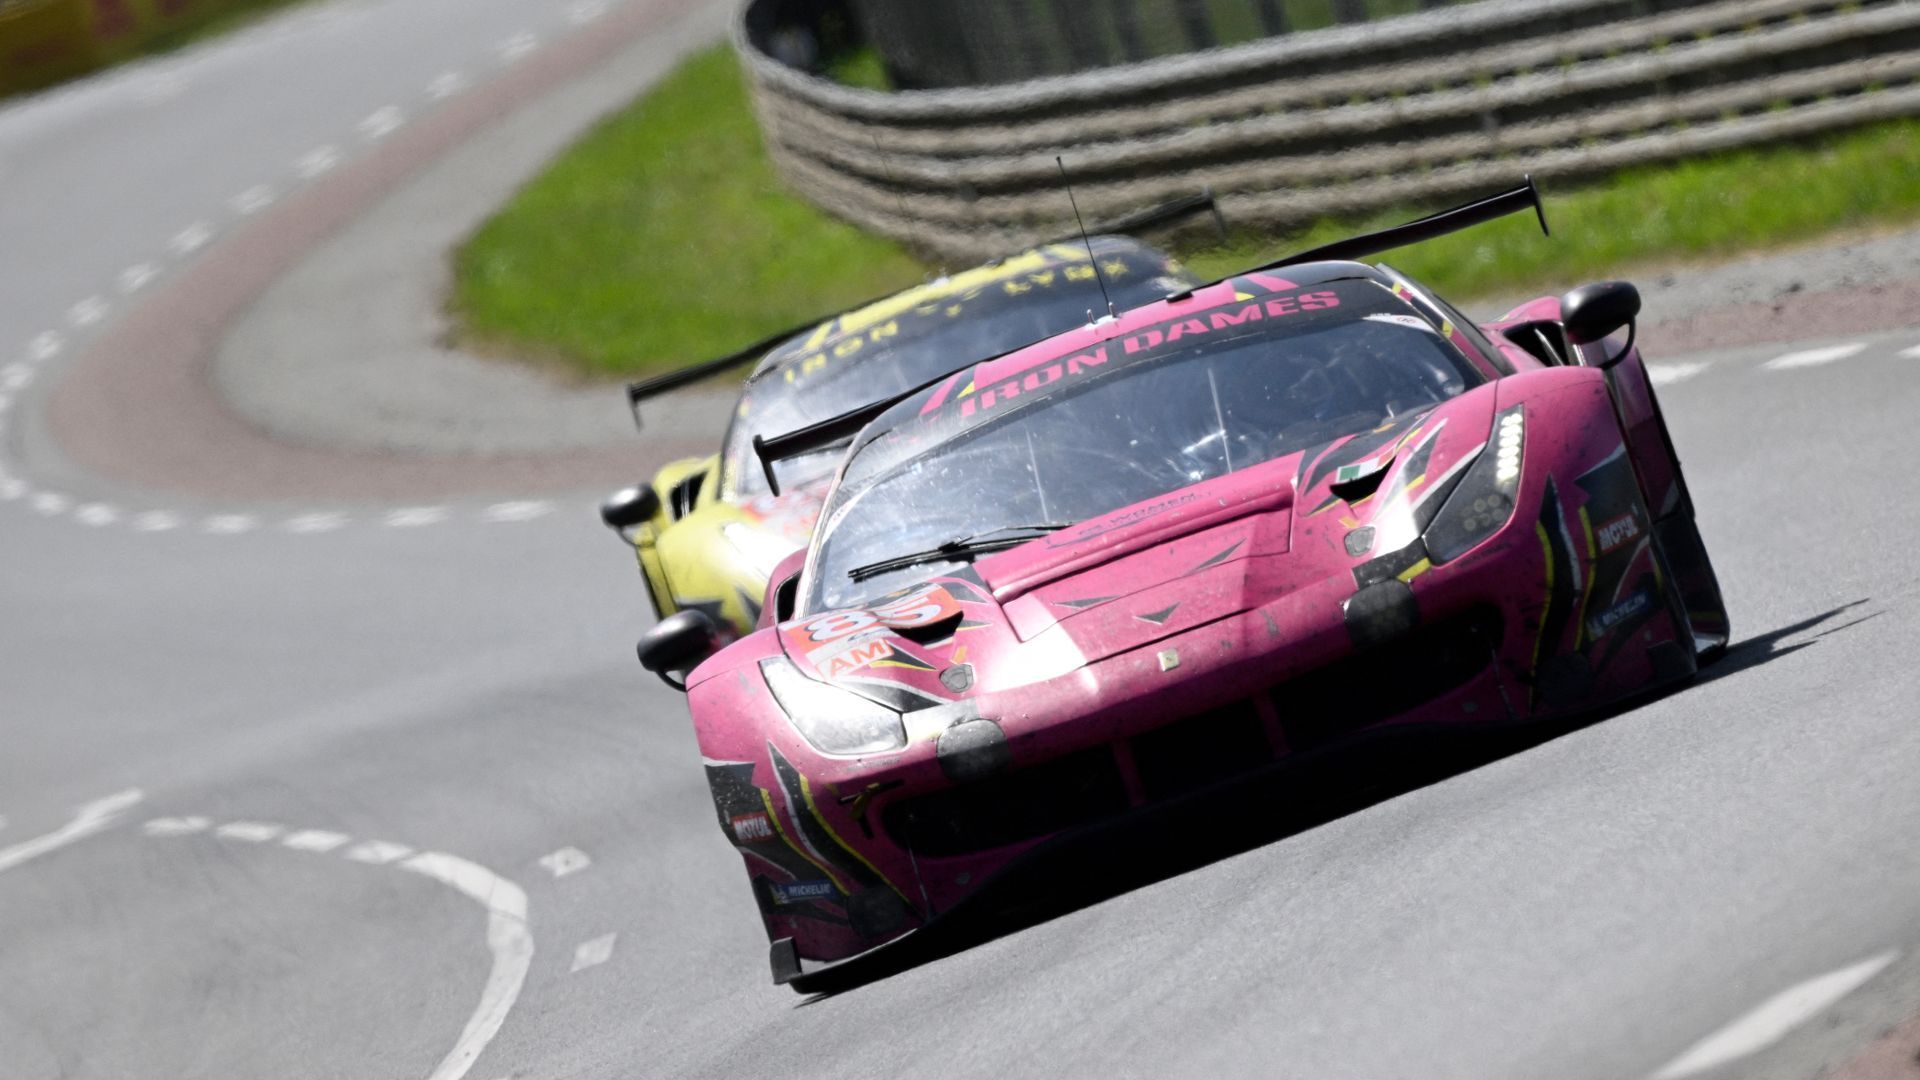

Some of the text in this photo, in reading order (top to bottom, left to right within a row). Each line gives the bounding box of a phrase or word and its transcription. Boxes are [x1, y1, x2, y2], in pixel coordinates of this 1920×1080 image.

[959, 291, 1341, 419] IRON DAMES
[829, 638, 888, 677] AM
[733, 815, 773, 841] MOTUL
